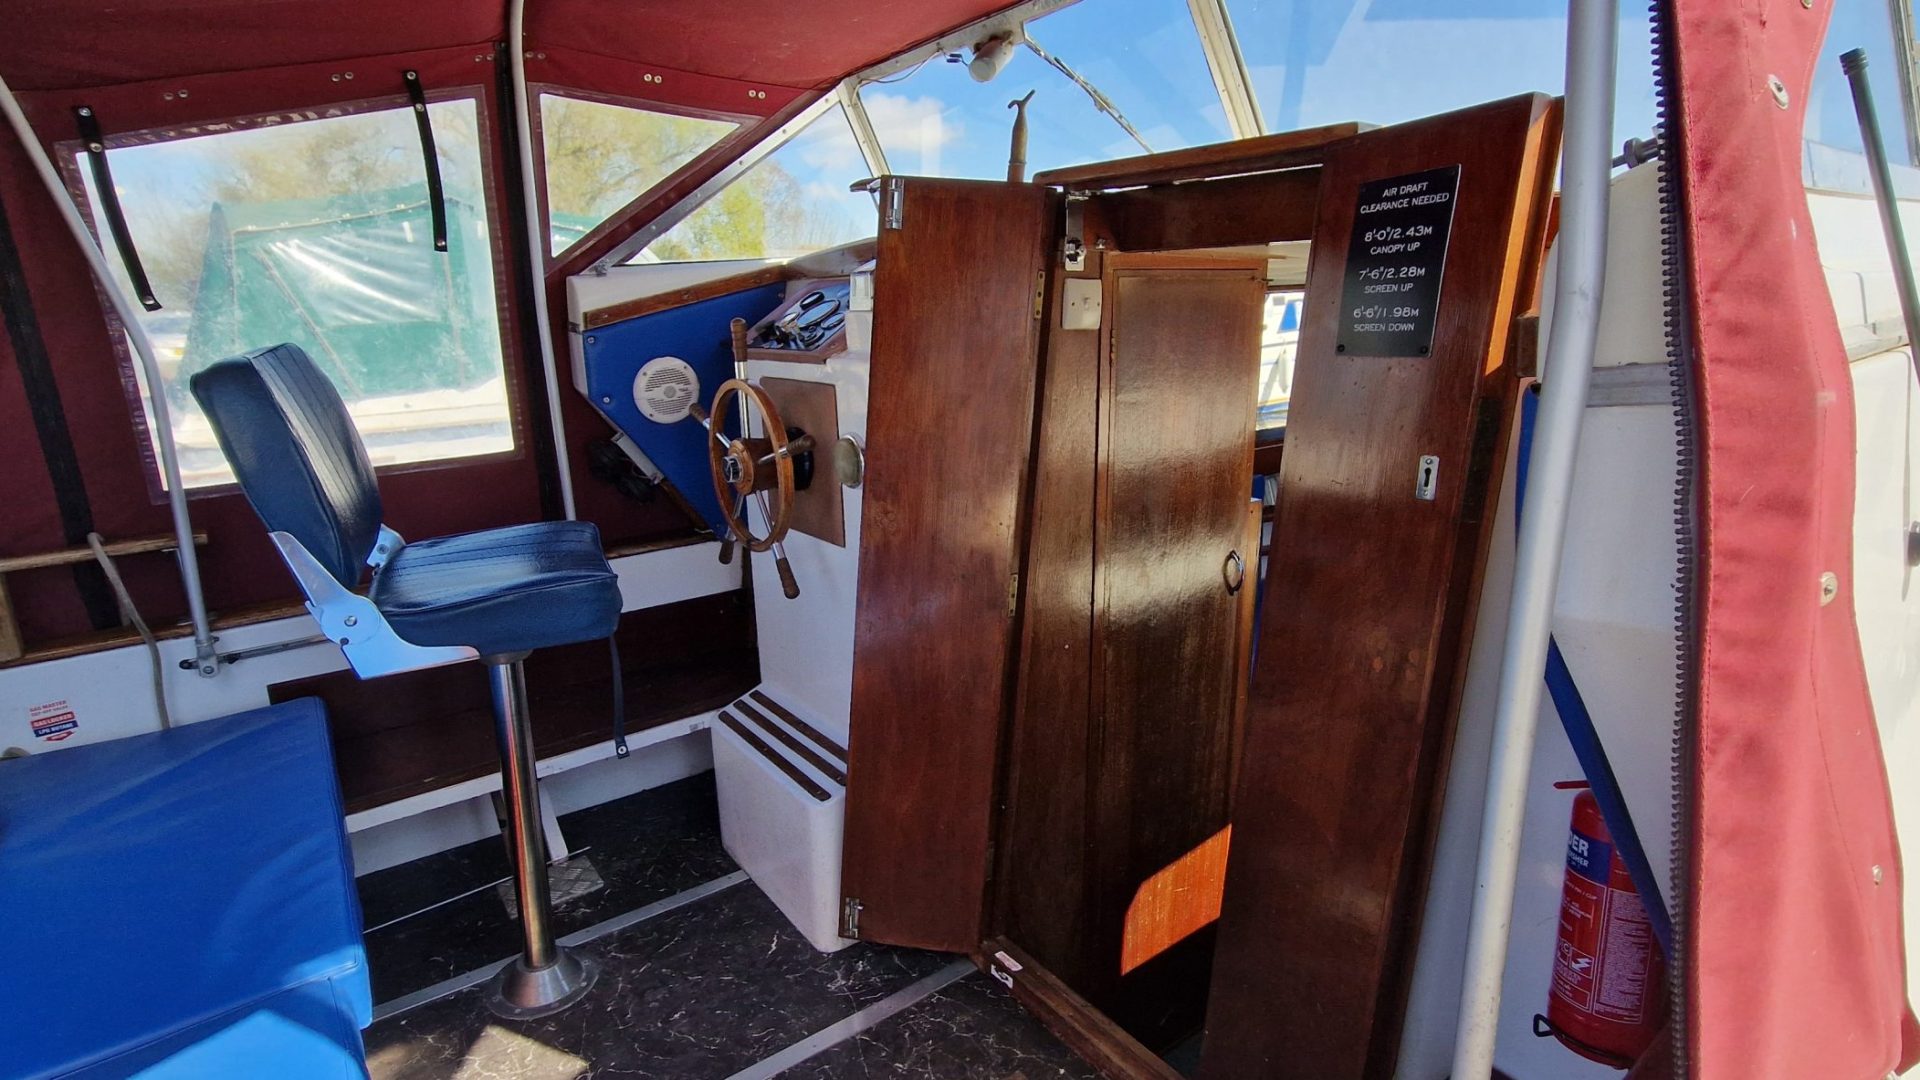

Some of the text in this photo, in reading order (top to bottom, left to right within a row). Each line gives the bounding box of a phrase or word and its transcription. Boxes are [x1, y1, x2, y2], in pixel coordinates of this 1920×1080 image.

[1383, 182, 1428, 198] AIR DRAFT
[1360, 192, 1450, 214] CLEARANCE NEEDED
[1370, 242, 1420, 255] CANOPY UP
[1364, 283, 1414, 294] SCREEN UP
[1353, 323, 1415, 332] SCREEN DOWN
